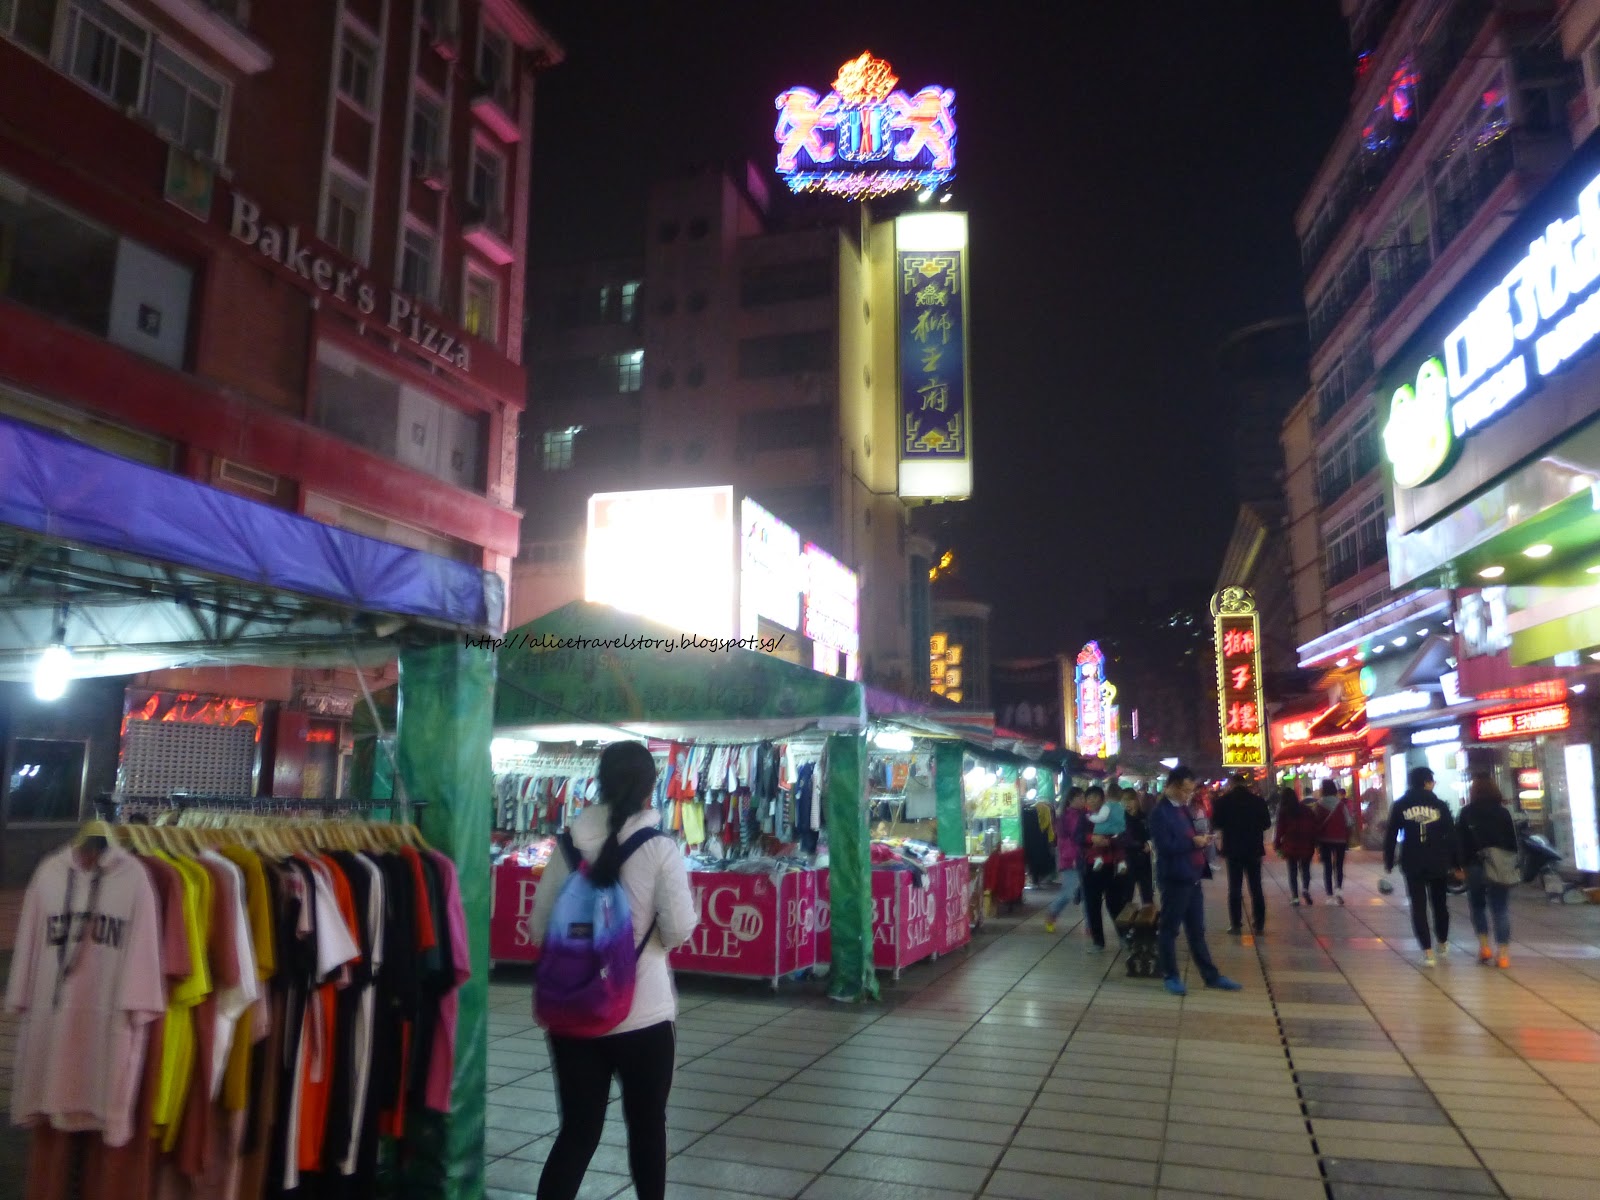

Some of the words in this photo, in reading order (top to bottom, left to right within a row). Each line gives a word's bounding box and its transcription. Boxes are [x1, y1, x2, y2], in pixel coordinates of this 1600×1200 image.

[230, 191, 376, 315] Baker's
[388, 289, 472, 372] Pizza
[692, 886, 742, 928] IG
[786, 897, 809, 928] BG
[907, 884, 934, 921] BIG
[676, 928, 742, 958] ALE
[872, 925, 897, 945] AL
[907, 919, 931, 949] SALE
